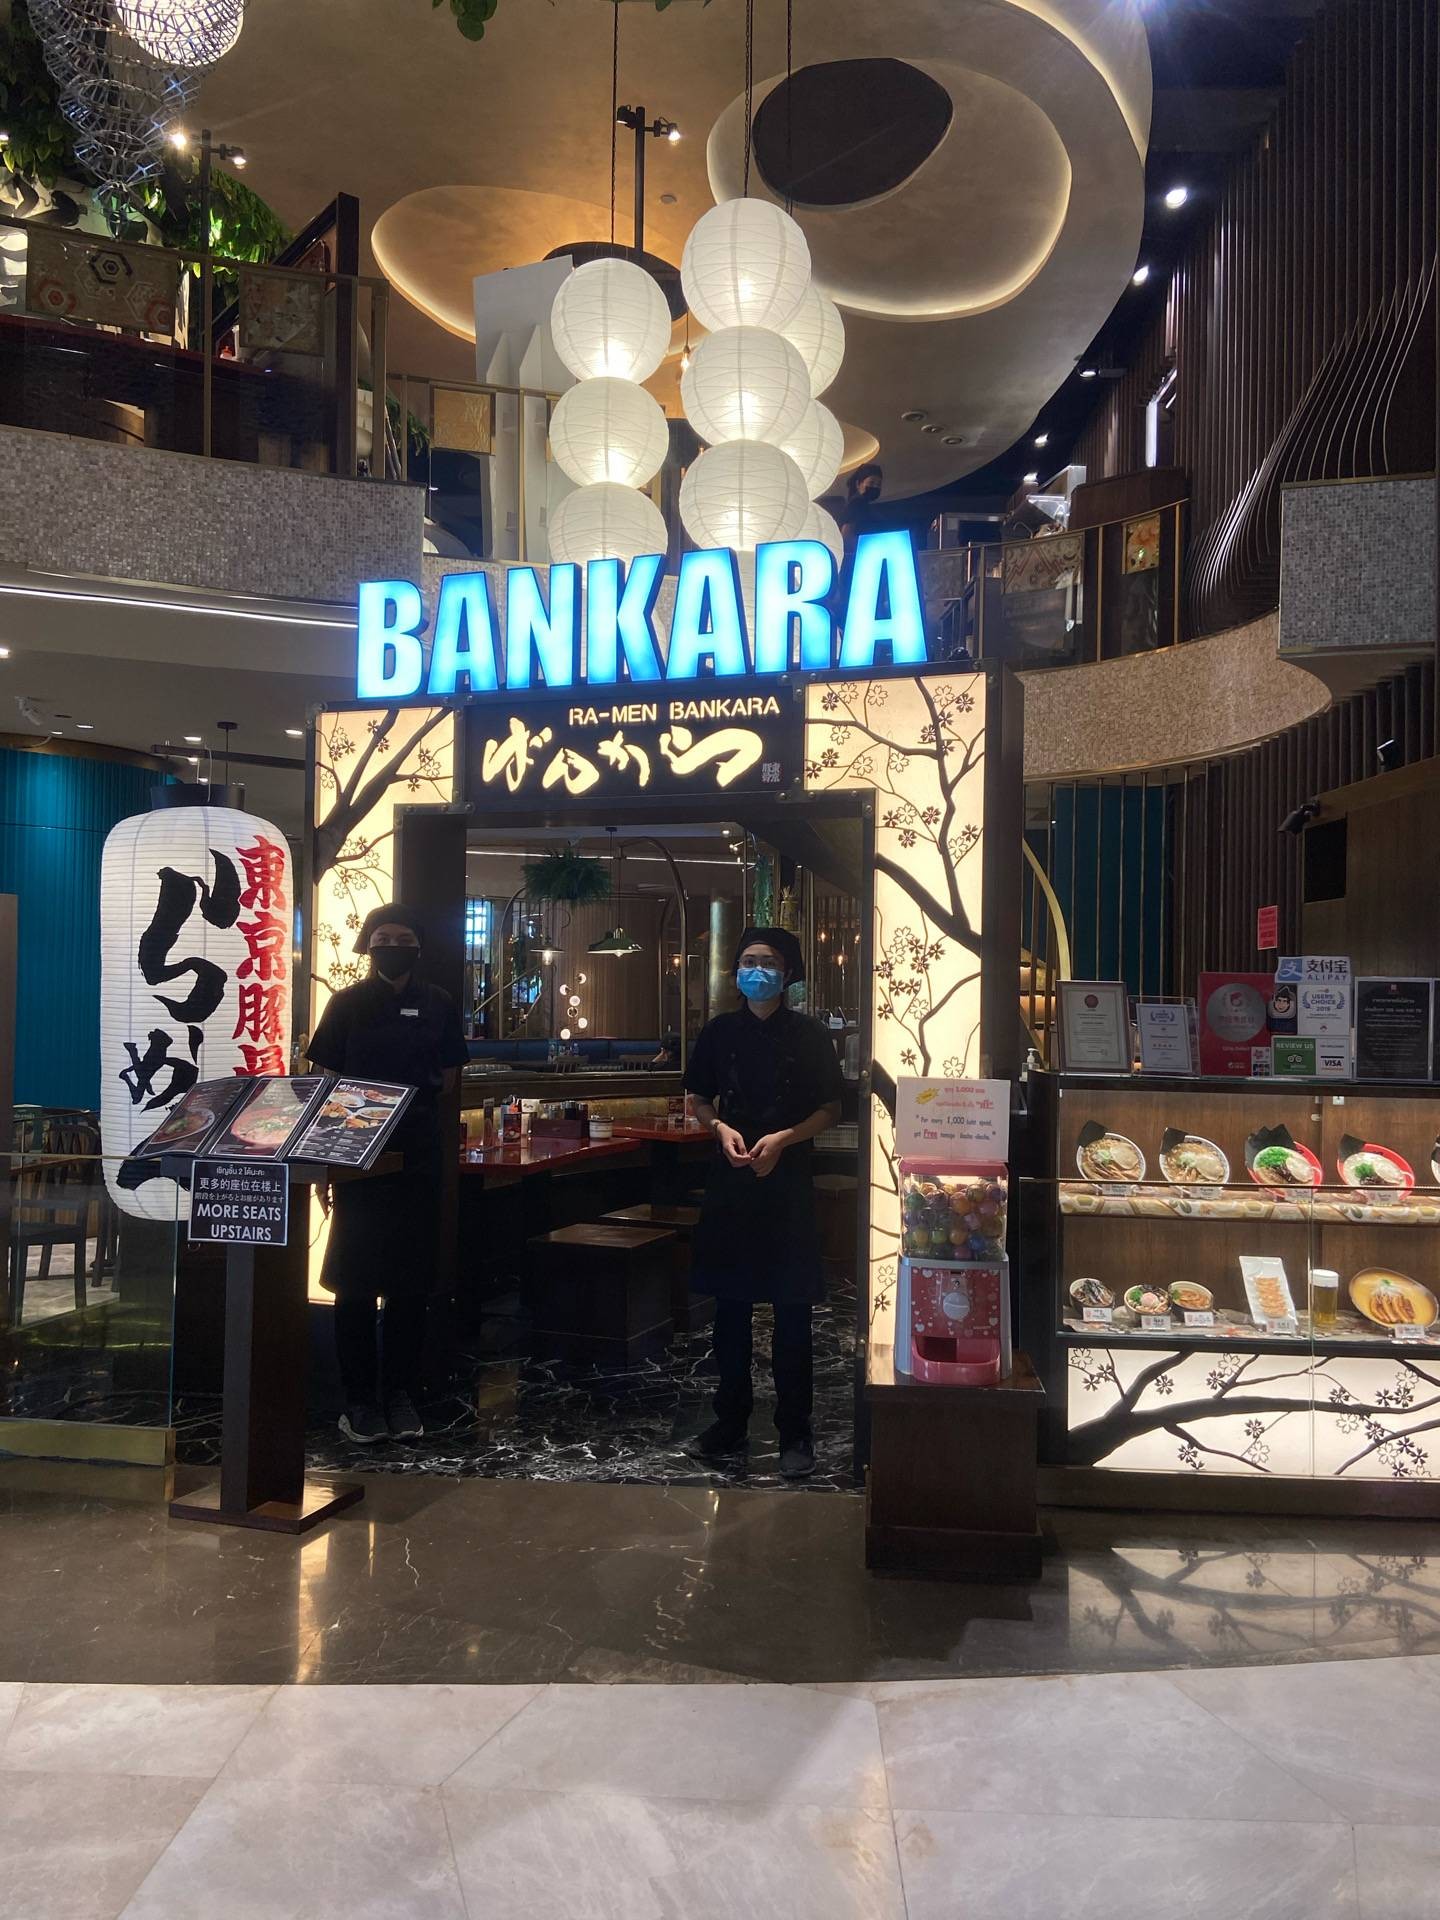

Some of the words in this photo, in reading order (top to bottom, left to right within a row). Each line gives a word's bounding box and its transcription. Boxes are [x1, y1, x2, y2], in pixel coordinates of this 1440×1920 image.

[356, 530, 928, 699] BANKARA
[569, 703, 657, 726] RA-MEN
[669, 696, 780, 720] BANKARA
[1307, 959, 1348, 974] 支付宝
[947, 1116, 965, 1126] 1,000
[923, 1129, 938, 1138] Free
[200, 1177, 281, 1193] 更多的座位在楼上
[197, 1203, 239, 1218] MORE
[242, 1205, 281, 1221] SEATS
[211, 1224, 272, 1240] UPSTAIRS
